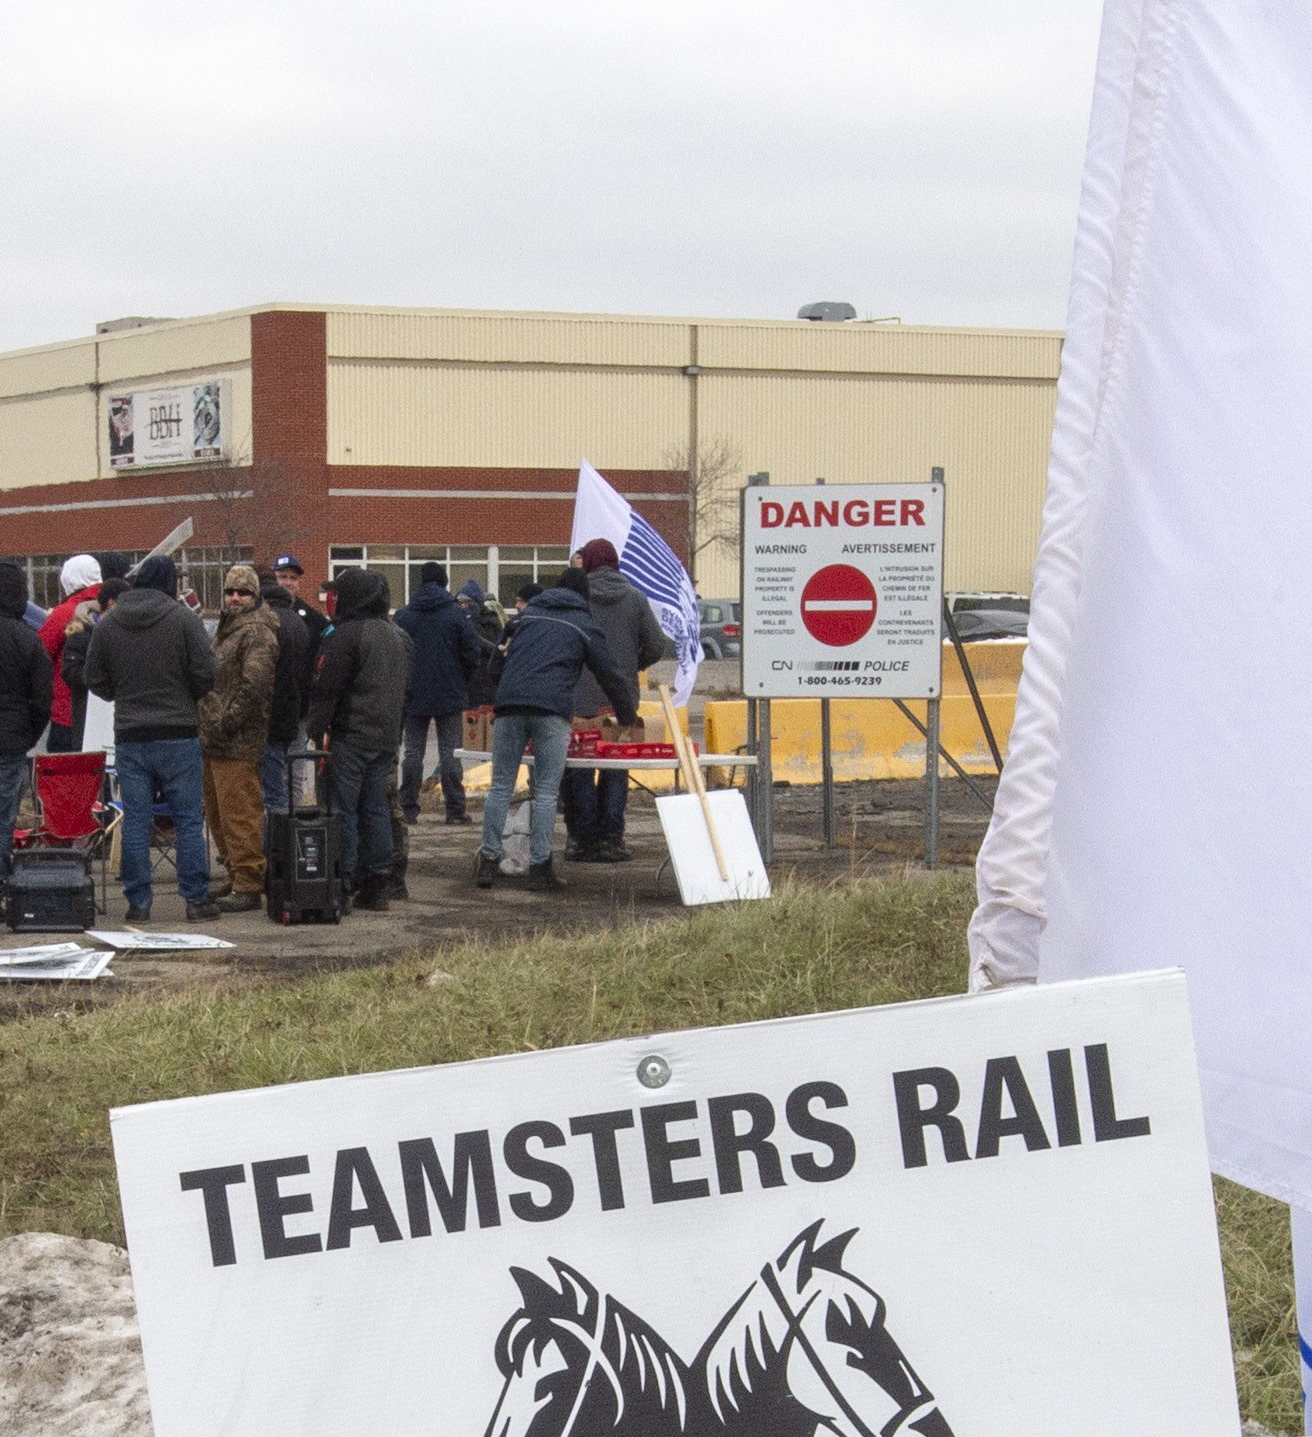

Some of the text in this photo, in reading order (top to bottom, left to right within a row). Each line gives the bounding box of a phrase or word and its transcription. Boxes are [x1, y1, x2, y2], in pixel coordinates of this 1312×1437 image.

[760, 499, 926, 528] DANGER
[755, 545, 807, 555] WARNING
[842, 543, 936, 554] AVERTISSEMENT
[772, 660, 910, 672] CN POLICE
[798, 676, 882, 686] 1-800-465-9239
[180, 1044, 1150, 1266] TEAMSTERS RAIL
